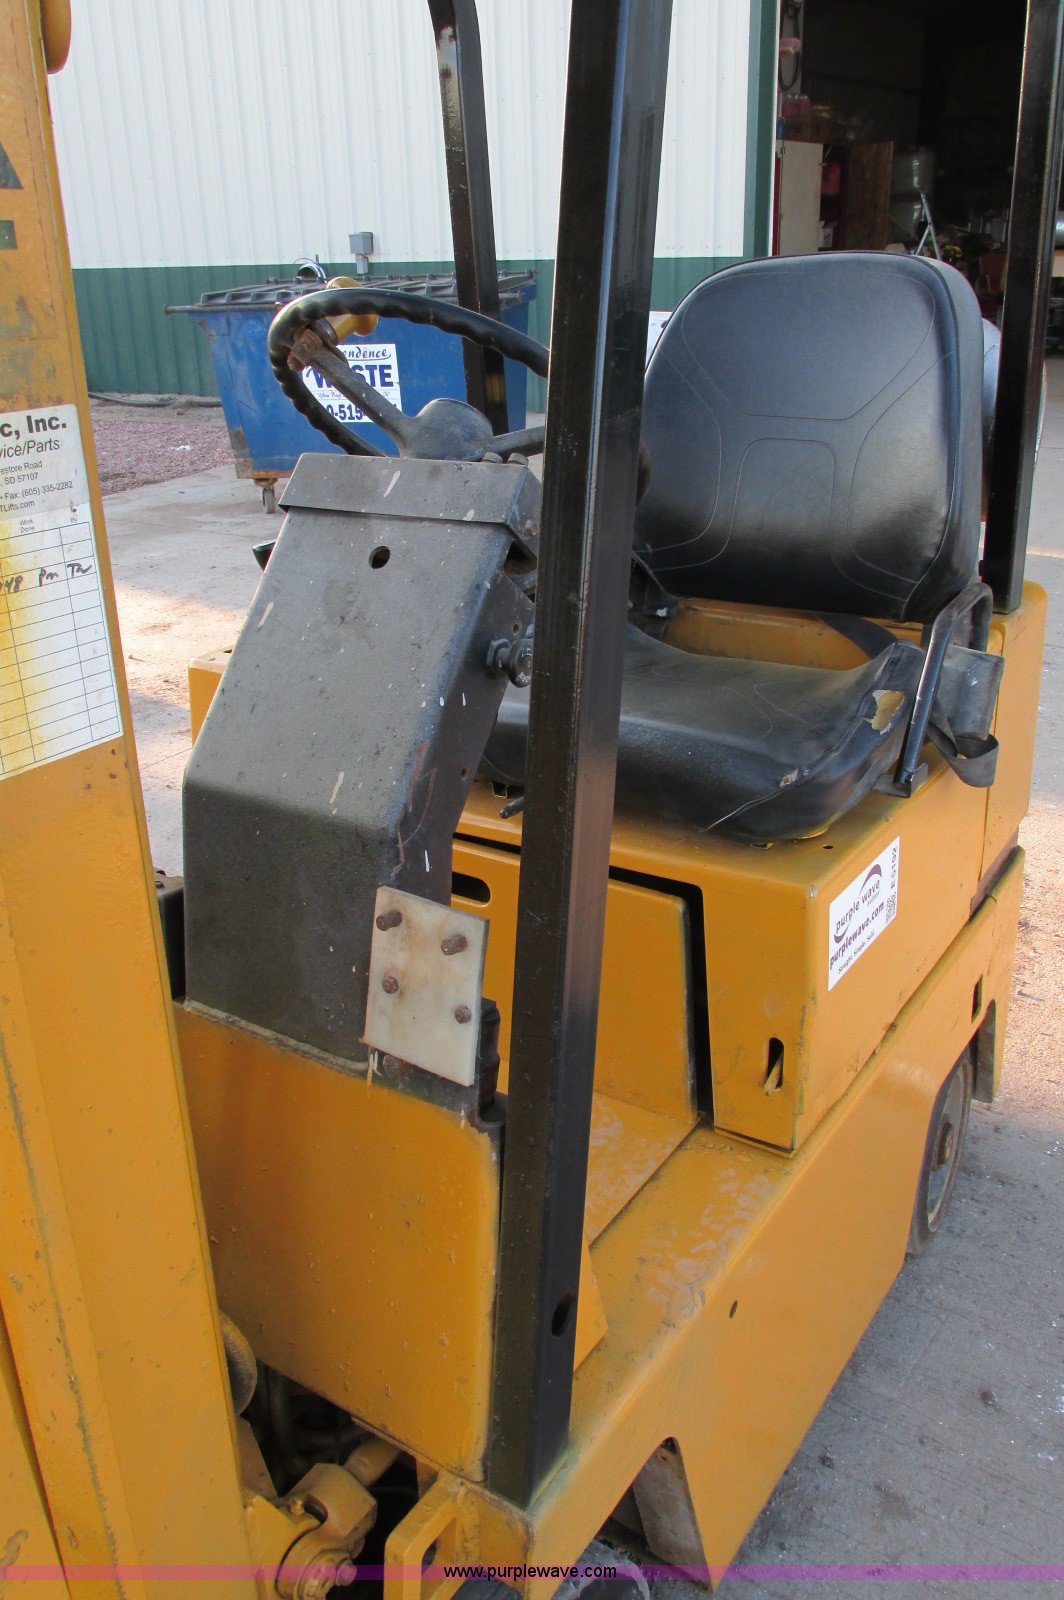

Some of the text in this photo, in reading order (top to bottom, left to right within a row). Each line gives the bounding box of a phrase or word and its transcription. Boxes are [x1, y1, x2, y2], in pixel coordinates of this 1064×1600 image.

[307, 364, 394, 388] WSTE
[26, 415, 67, 434] Inc.
[23, 460, 43, 471] Road
[4, 472, 39, 485] SD 57107
[21, 487, 41, 499] (605)
[42, 481, 73, 494] 335-2282
[20, 518, 33, 526] Work
[20, 525, 35, 533] Done
[836, 879, 881, 934] purple wave
[830, 901, 885, 970] purplewave.com
